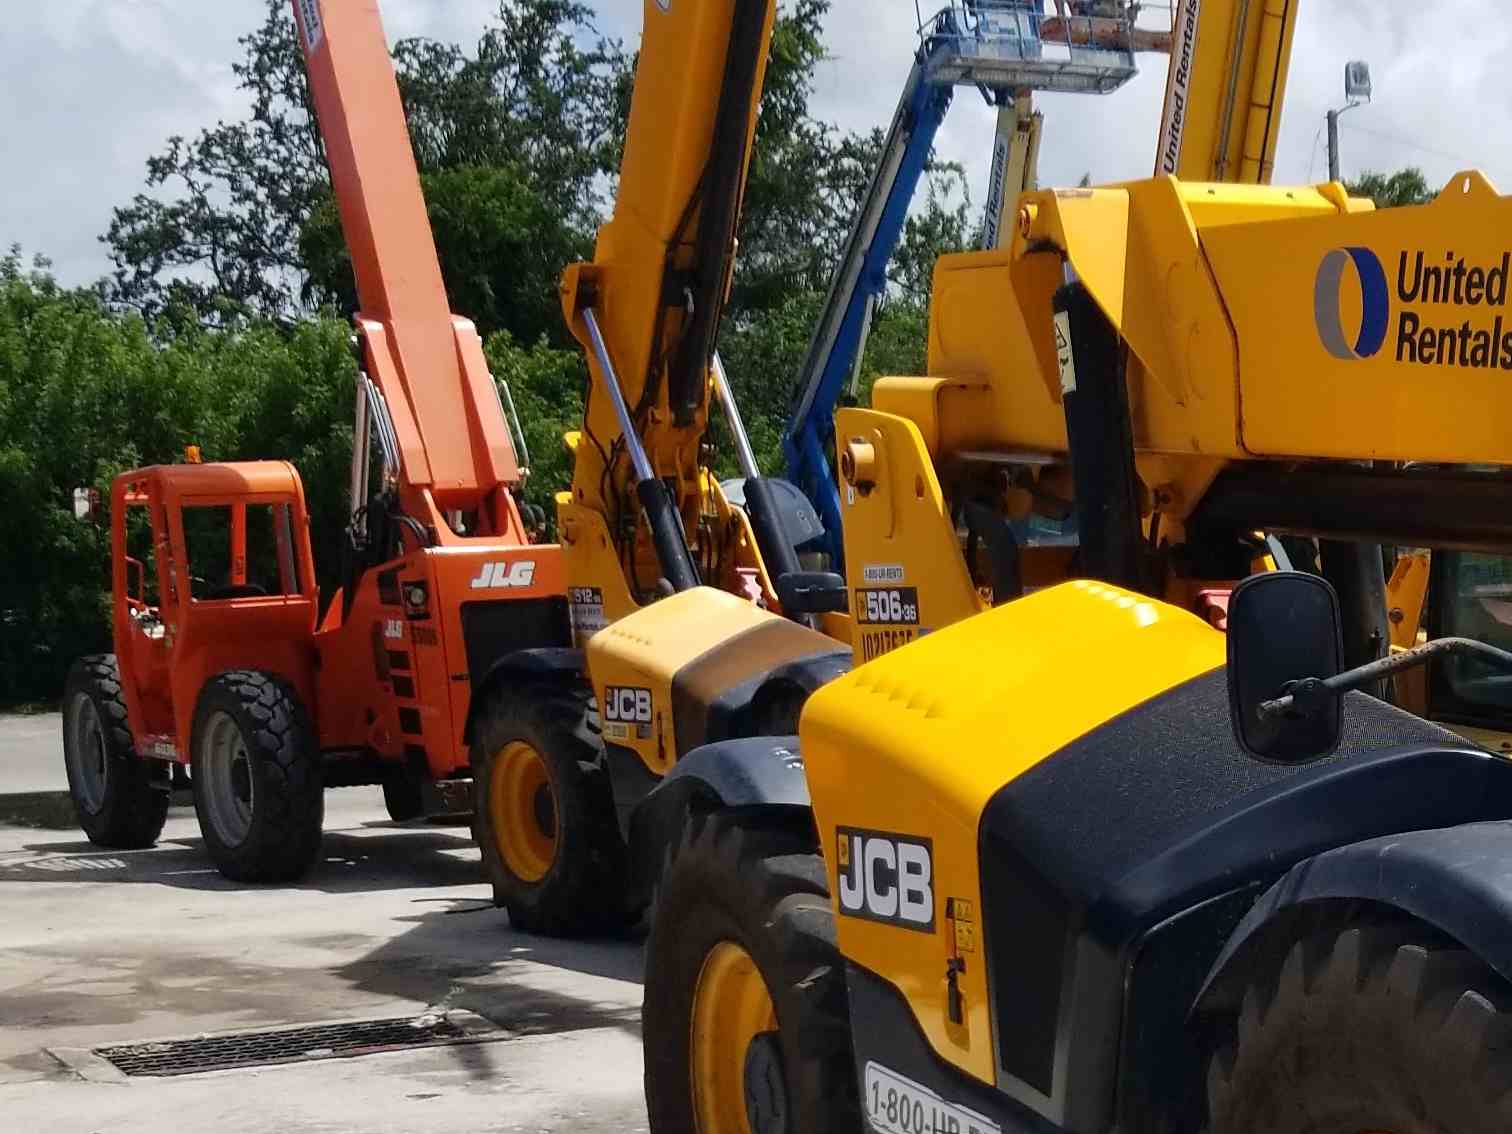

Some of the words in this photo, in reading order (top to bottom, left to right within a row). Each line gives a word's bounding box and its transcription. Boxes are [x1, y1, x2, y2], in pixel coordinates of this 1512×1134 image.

[1164, 93, 1185, 174] United
[1175, 0, 1198, 89] Rentals
[1396, 250, 1512, 306] United
[470, 560, 536, 589] JLG
[606, 688, 652, 722] JCB
[839, 835, 934, 924] JCB
